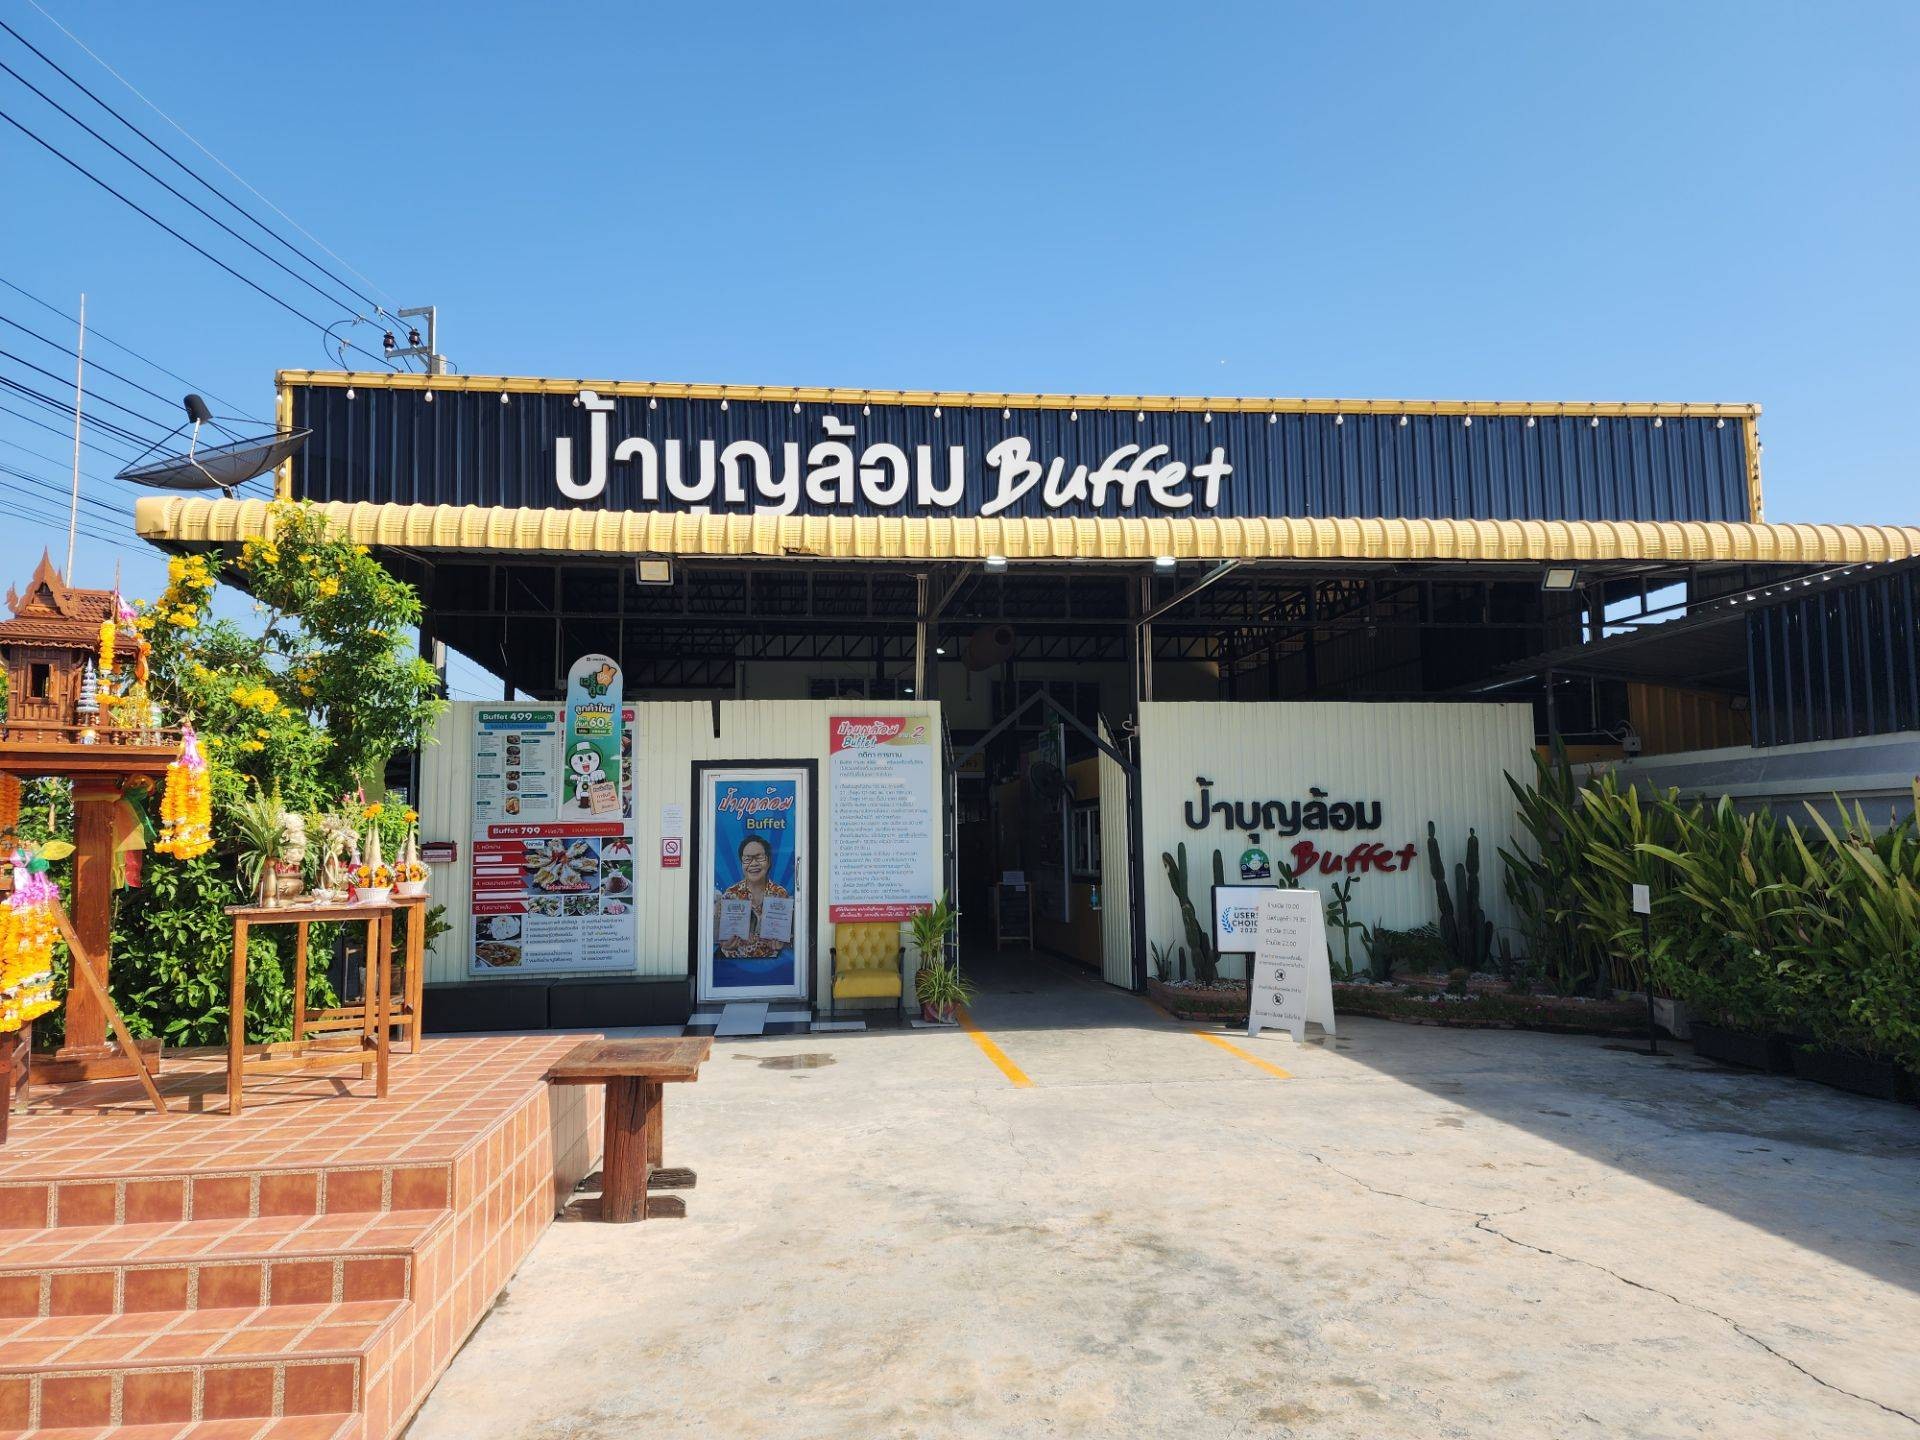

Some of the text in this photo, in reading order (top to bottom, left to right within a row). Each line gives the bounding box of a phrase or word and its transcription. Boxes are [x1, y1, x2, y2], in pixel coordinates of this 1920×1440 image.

[981, 436, 1234, 517] Buffet
[510, 712, 533, 721] 499
[842, 735, 877, 749] Buffet
[717, 787, 794, 821] ป้าบุญล้อม
[1184, 776, 1382, 845] ป้าบุญล้อม
[492, 826, 518, 835] Buffet
[520, 826, 541, 835] 799
[747, 818, 786, 829] Buffet
[1290, 840, 1418, 878] Buffet
